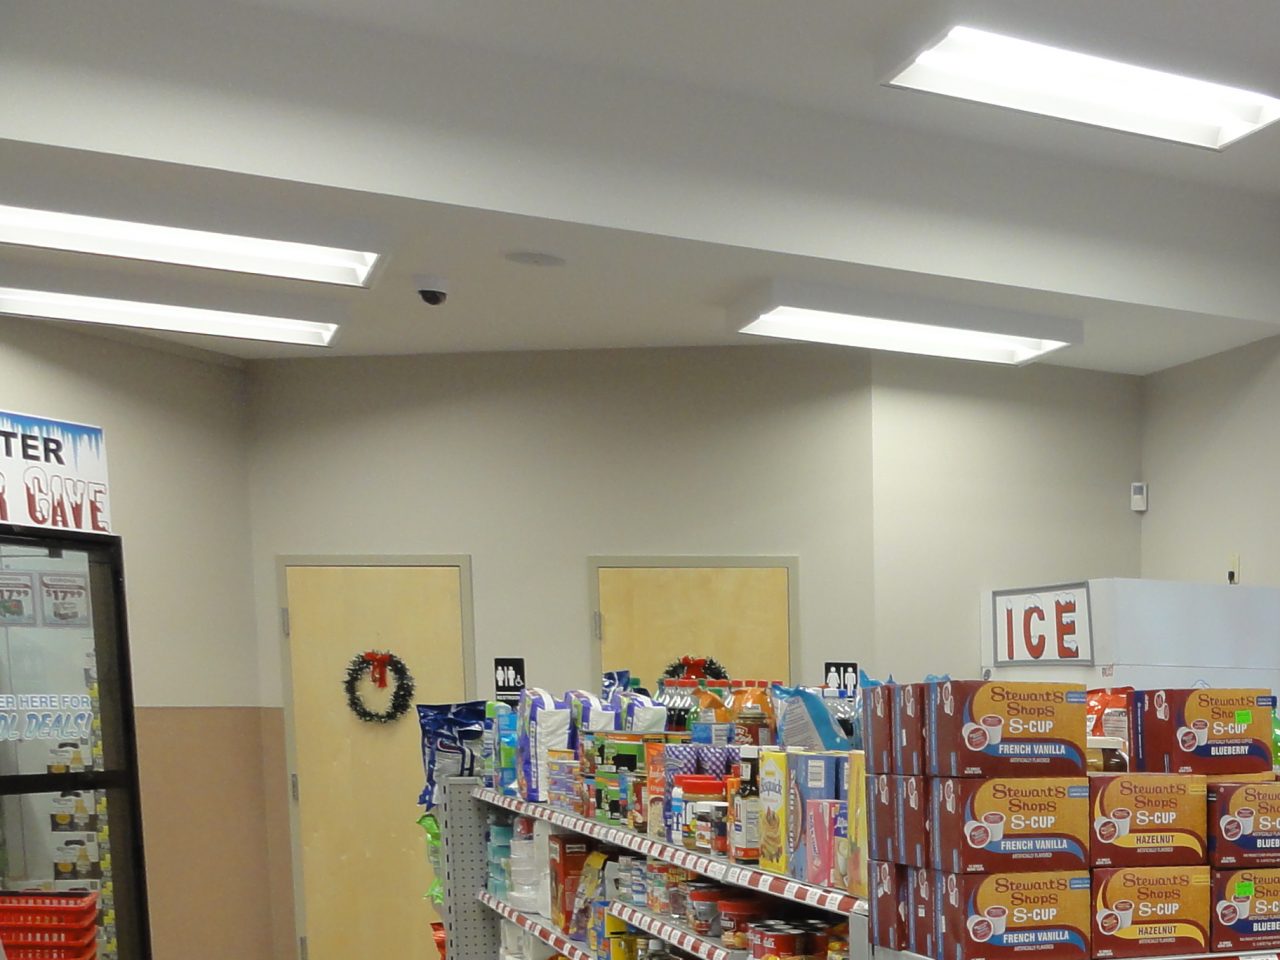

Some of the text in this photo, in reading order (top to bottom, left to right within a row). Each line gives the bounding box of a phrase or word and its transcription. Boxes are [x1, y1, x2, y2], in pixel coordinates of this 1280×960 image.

[1005, 592, 1080, 661] ICE
[20, 695, 91, 709] HERE FOR
[1006, 702, 1055, 717] Shops
[1009, 718, 1054, 734] S-CUP
[1213, 721, 1248, 735] S-CUP
[998, 744, 1066, 755] FRENCH VANILLA
[1210, 745, 1249, 756] BLUEBERRY
[1008, 798, 1057, 813] Shops
[1134, 795, 1178, 809] Shops
[1010, 814, 1055, 830] S-CUP
[1136, 811, 1177, 825] S-CUP
[1001, 839, 1068, 851] FRENCH VANILLA
[1136, 834, 1175, 845] HAZELNUT
[1010, 892, 1058, 906] Shops
[1137, 887, 1181, 901] Shops
[1013, 907, 1057, 923] S-CUP
[1138, 902, 1180, 917] S-CUP
[1003, 930, 1070, 944] FRENCH VANILLA
[1138, 925, 1177, 936] HAZELNUT
